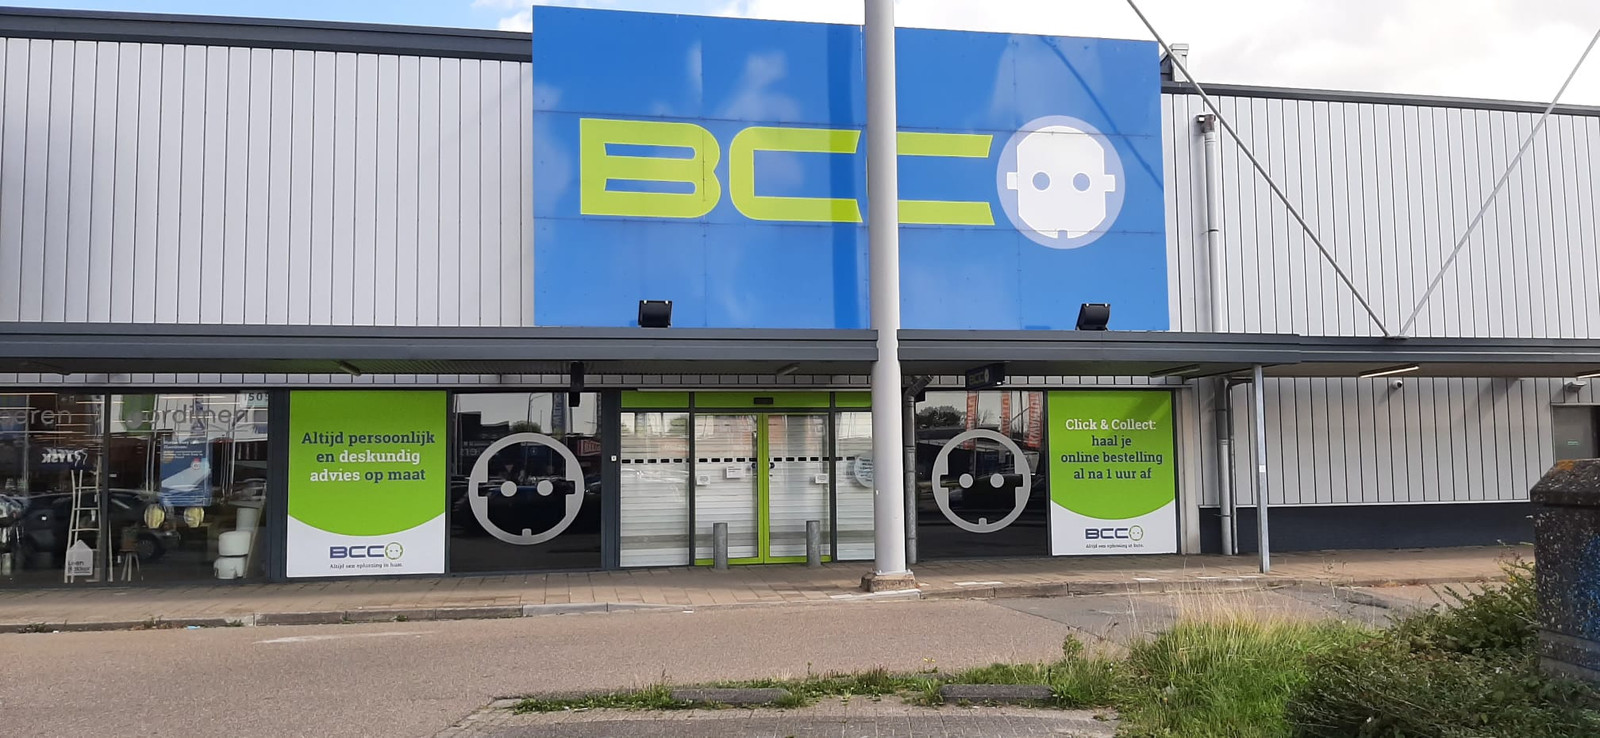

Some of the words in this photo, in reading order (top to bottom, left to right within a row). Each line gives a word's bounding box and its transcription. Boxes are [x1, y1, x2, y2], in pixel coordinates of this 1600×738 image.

[580, 117, 995, 226] BCC
[1065, 418, 1098, 430] Click
[1100, 419, 1109, 430] &
[1111, 418, 1157, 430] Collect:
[301, 431, 344, 447] Altijd
[348, 431, 435, 447] persoonlijk
[1091, 435, 1118, 446] haal
[1120, 435, 1132, 449] je
[316, 453, 335, 462] en
[339, 449, 420, 465] deskundig
[1060, 451, 1100, 463] online
[1102, 451, 1163, 465] bestelling
[310, 468, 360, 482] advies
[364, 471, 384, 483] op
[388, 469, 426, 480] maat
[1073, 468, 1084, 479] al
[1088, 470, 1103, 479] na
[1106, 468, 1112, 479] 1
[1115, 470, 1137, 479] uur
[1139, 467, 1152, 479] af
[1085, 528, 1129, 539] BCC
[330, 545, 385, 558] BCC
